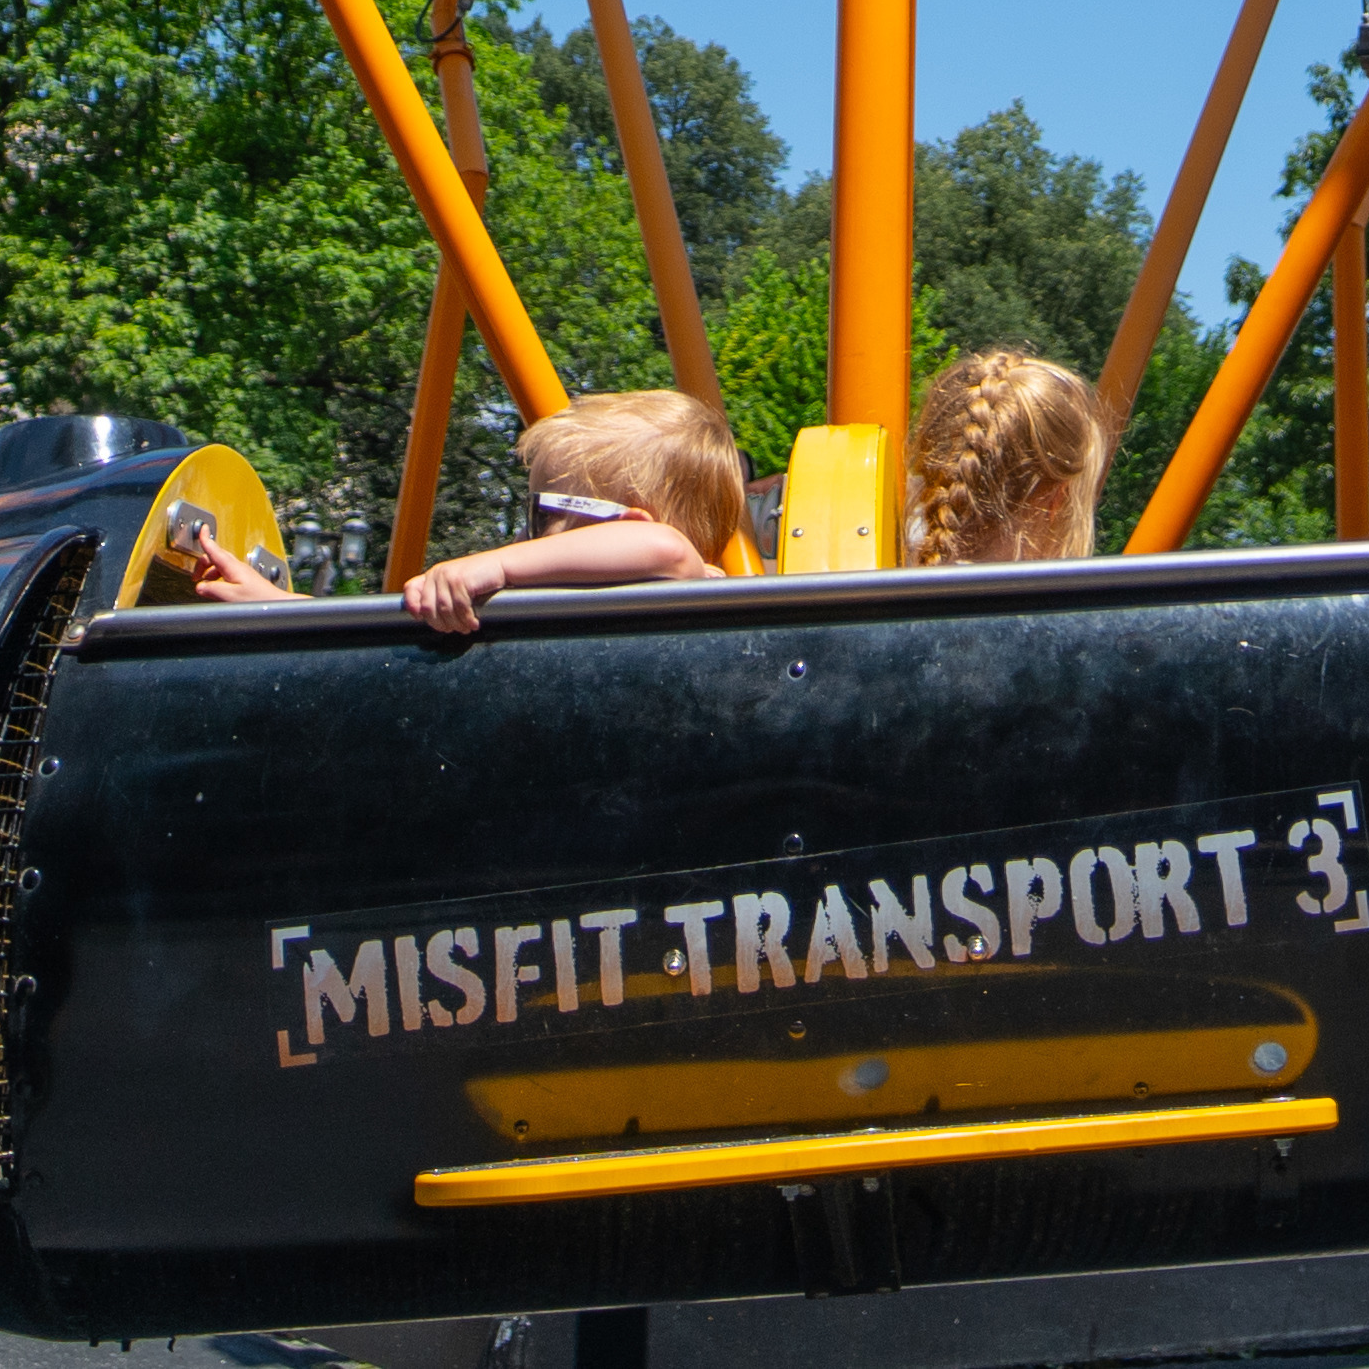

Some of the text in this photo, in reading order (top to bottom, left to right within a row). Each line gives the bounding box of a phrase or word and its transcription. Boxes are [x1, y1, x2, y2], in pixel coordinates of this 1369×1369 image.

[303, 818, 1351, 1045] MISFIT TRANSPORT 3
